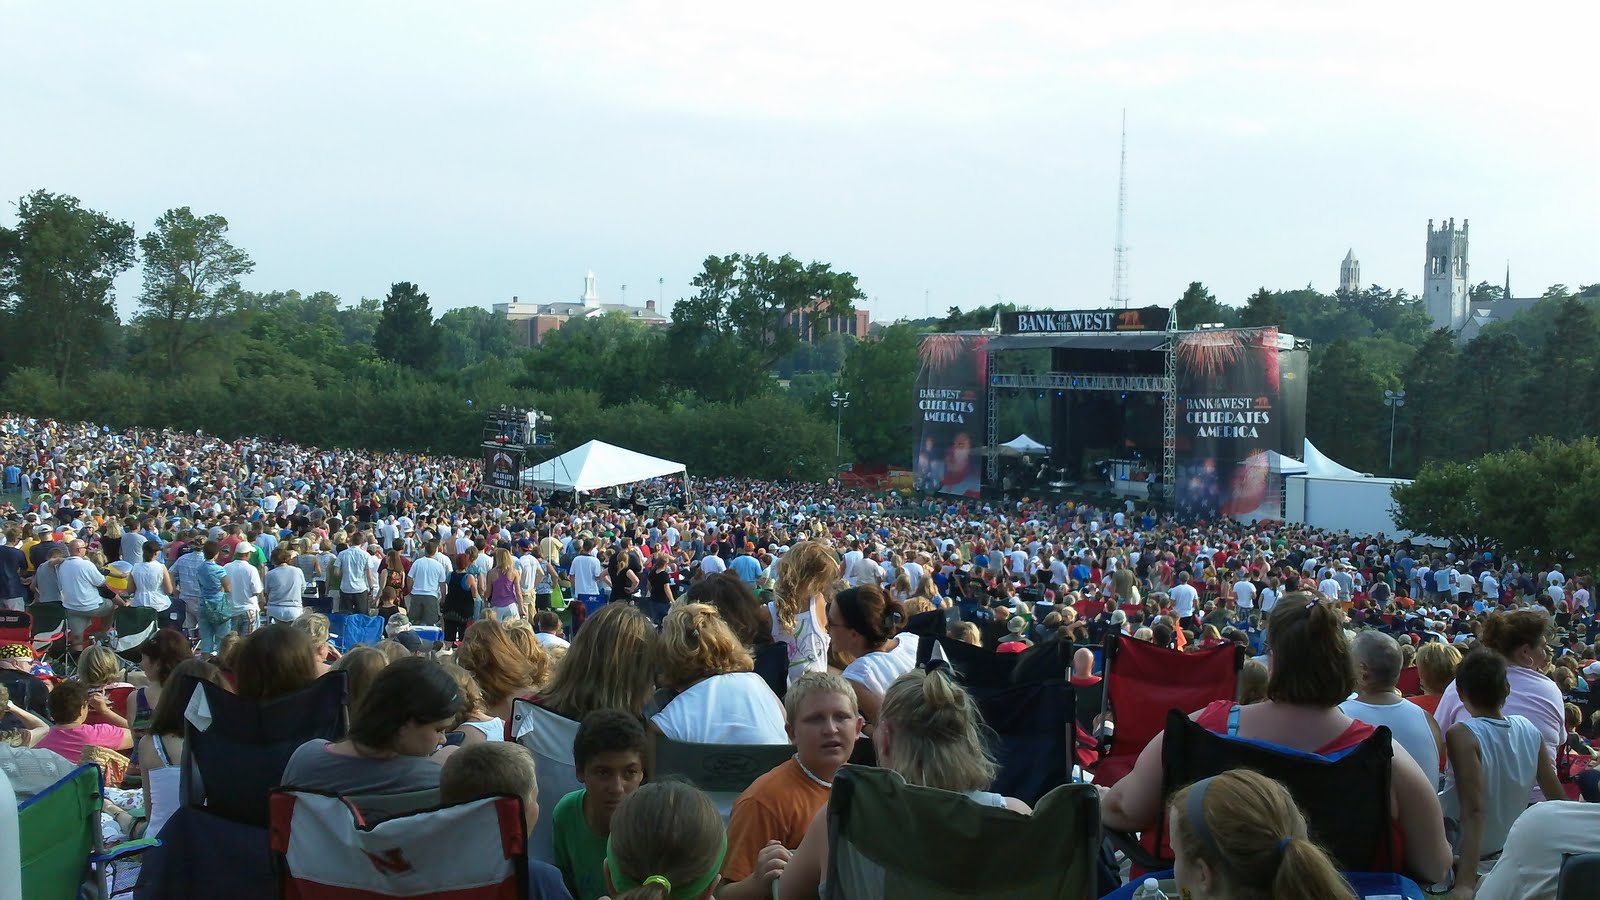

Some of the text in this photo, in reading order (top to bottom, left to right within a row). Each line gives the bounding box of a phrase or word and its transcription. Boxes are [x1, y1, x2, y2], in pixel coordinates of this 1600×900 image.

[1018, 314, 1056, 331] BANK
[1056, 322, 1071, 330] THE
[1070, 313, 1115, 330] WEST
[920, 389, 936, 399] BAK
[1186, 398, 1214, 410] BANK
[1221, 398, 1252, 409] WEST
[1186, 411, 1270, 424] CELEBRATES
[1197, 425, 1259, 438] AMERICA
